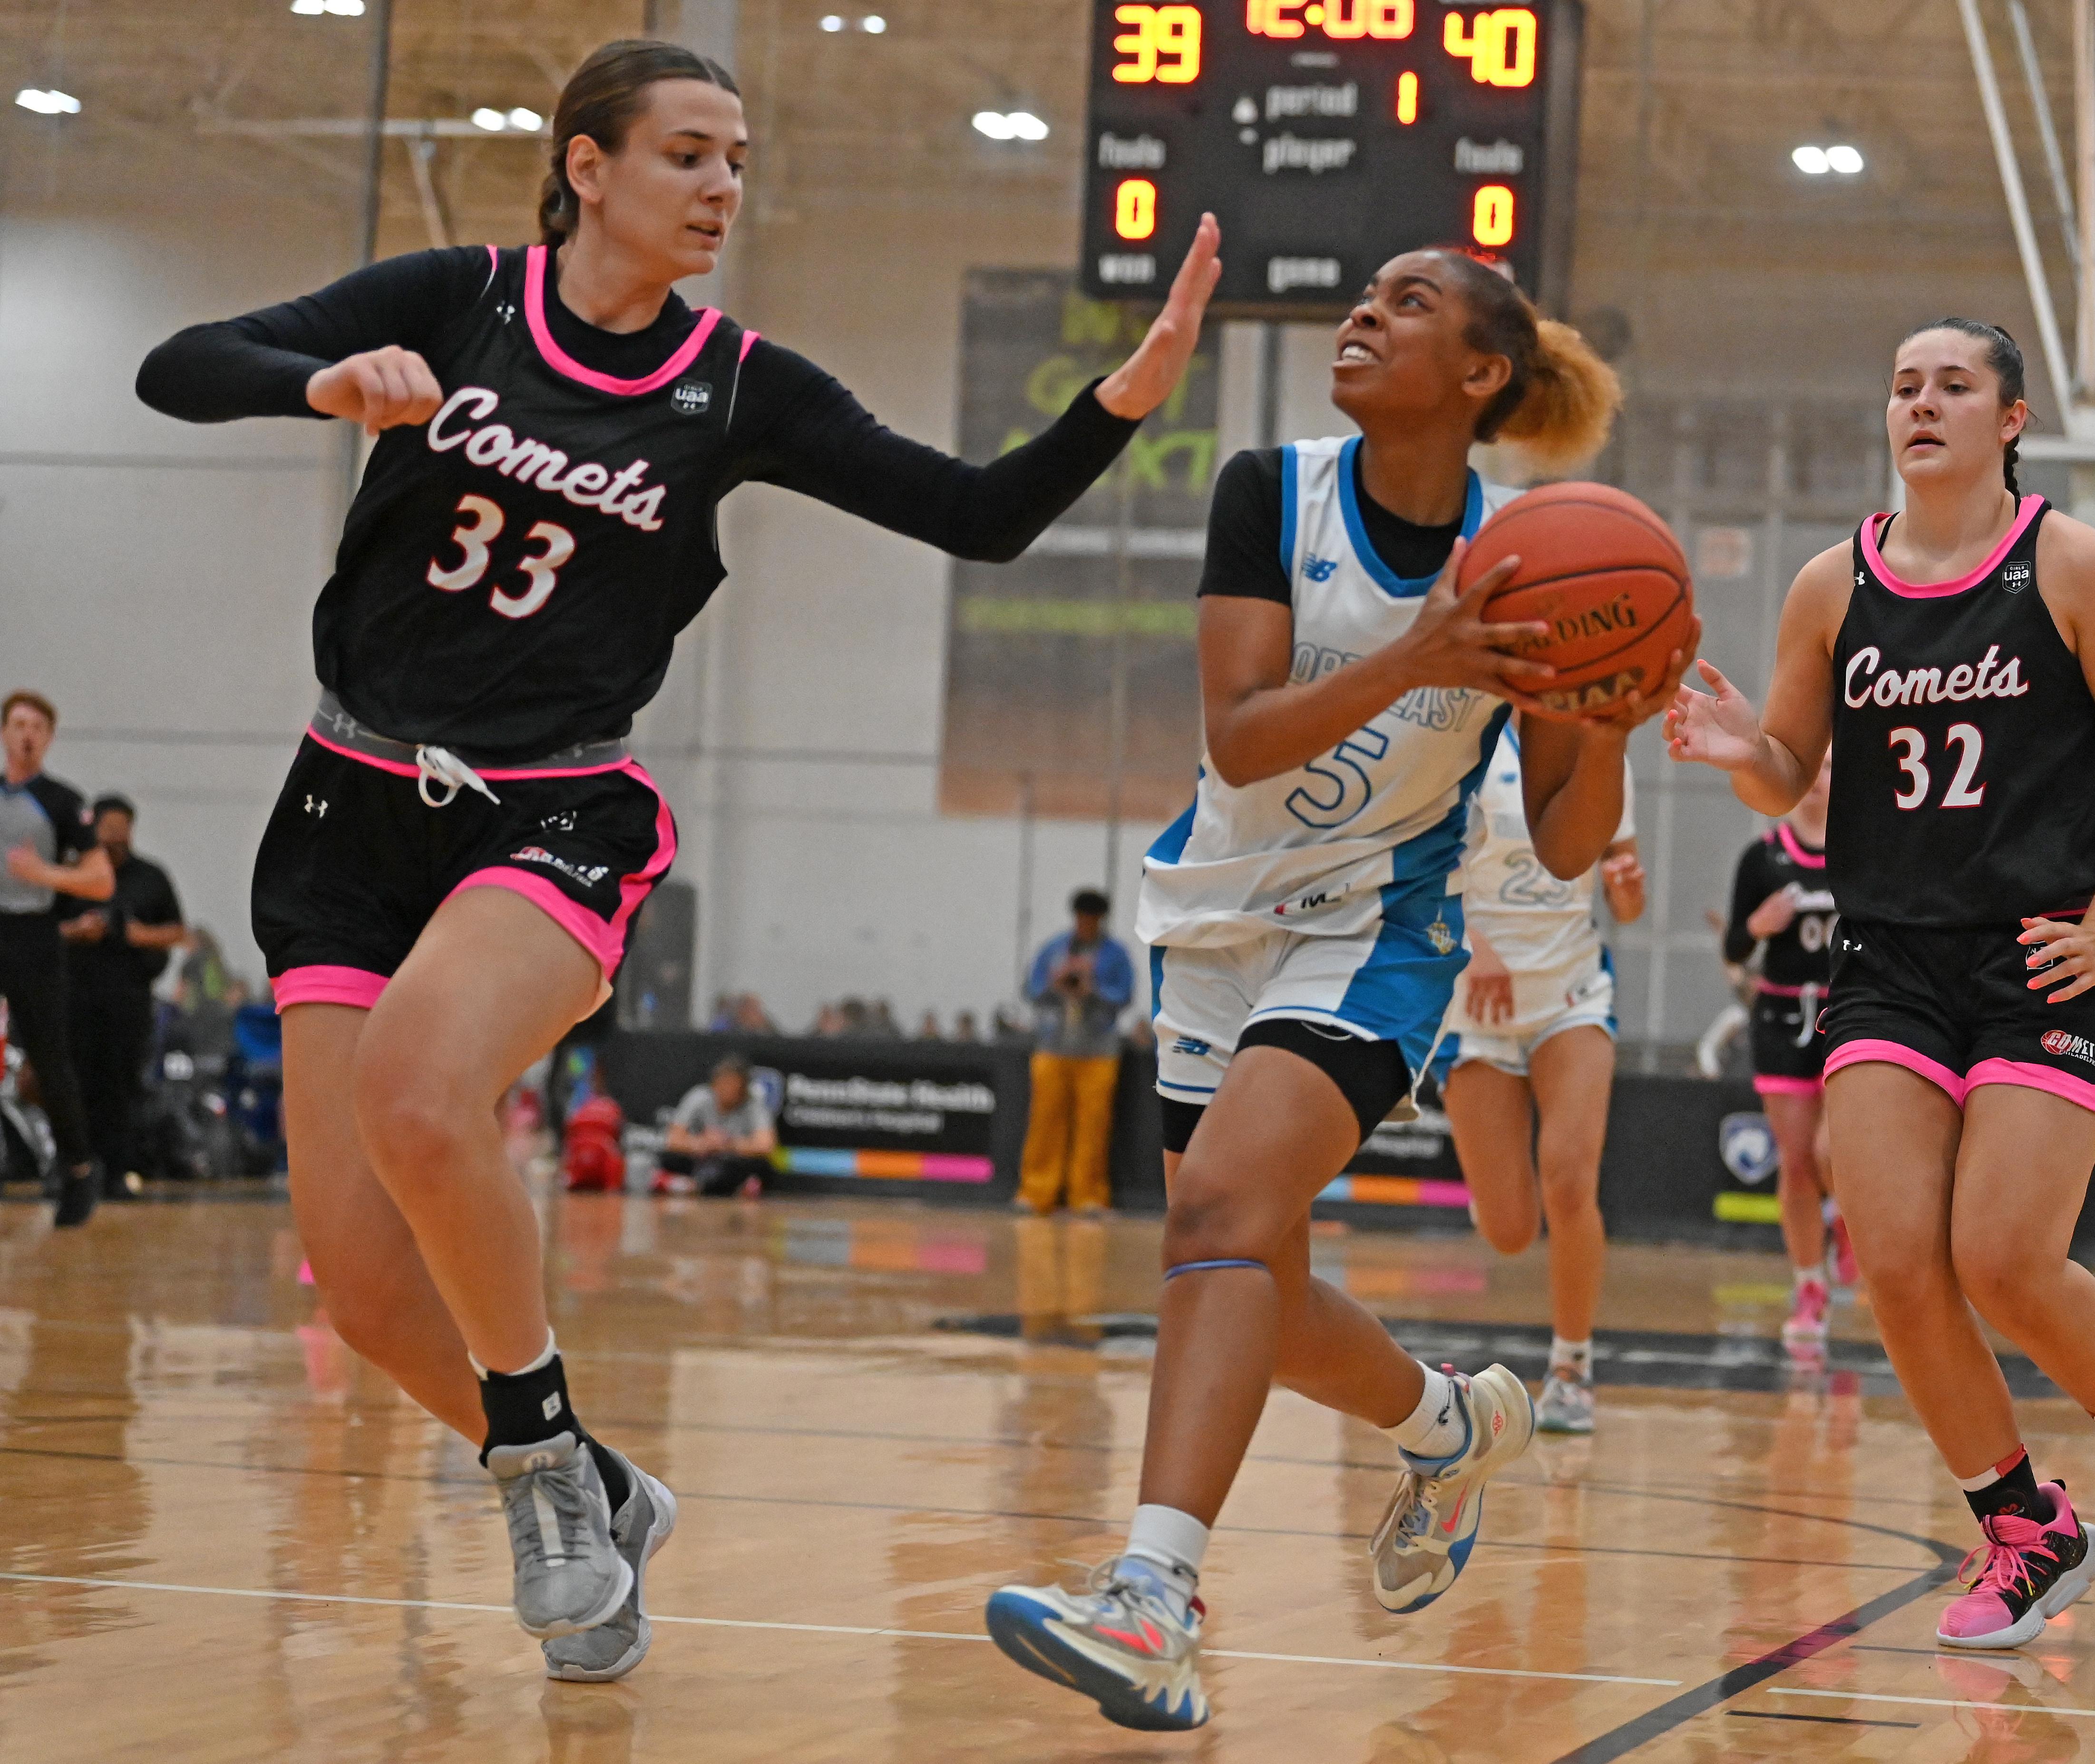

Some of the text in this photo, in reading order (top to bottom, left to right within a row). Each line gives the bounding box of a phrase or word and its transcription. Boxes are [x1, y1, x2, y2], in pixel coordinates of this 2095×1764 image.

[1111, 5, 1202, 84] 39
[1443, 8, 1538, 88] 40
[1397, 71, 1418, 125] 1
[1115, 179, 1156, 240] 0
[1472, 185, 1514, 246] 0
[427, 386, 667, 532] Comets
[426, 493, 576, 620] 33
[2004, 569, 2029, 581] uaa
[1844, 644, 2029, 708] Comets
[1285, 725, 1390, 829] 5
[1889, 721, 1987, 810] 32
